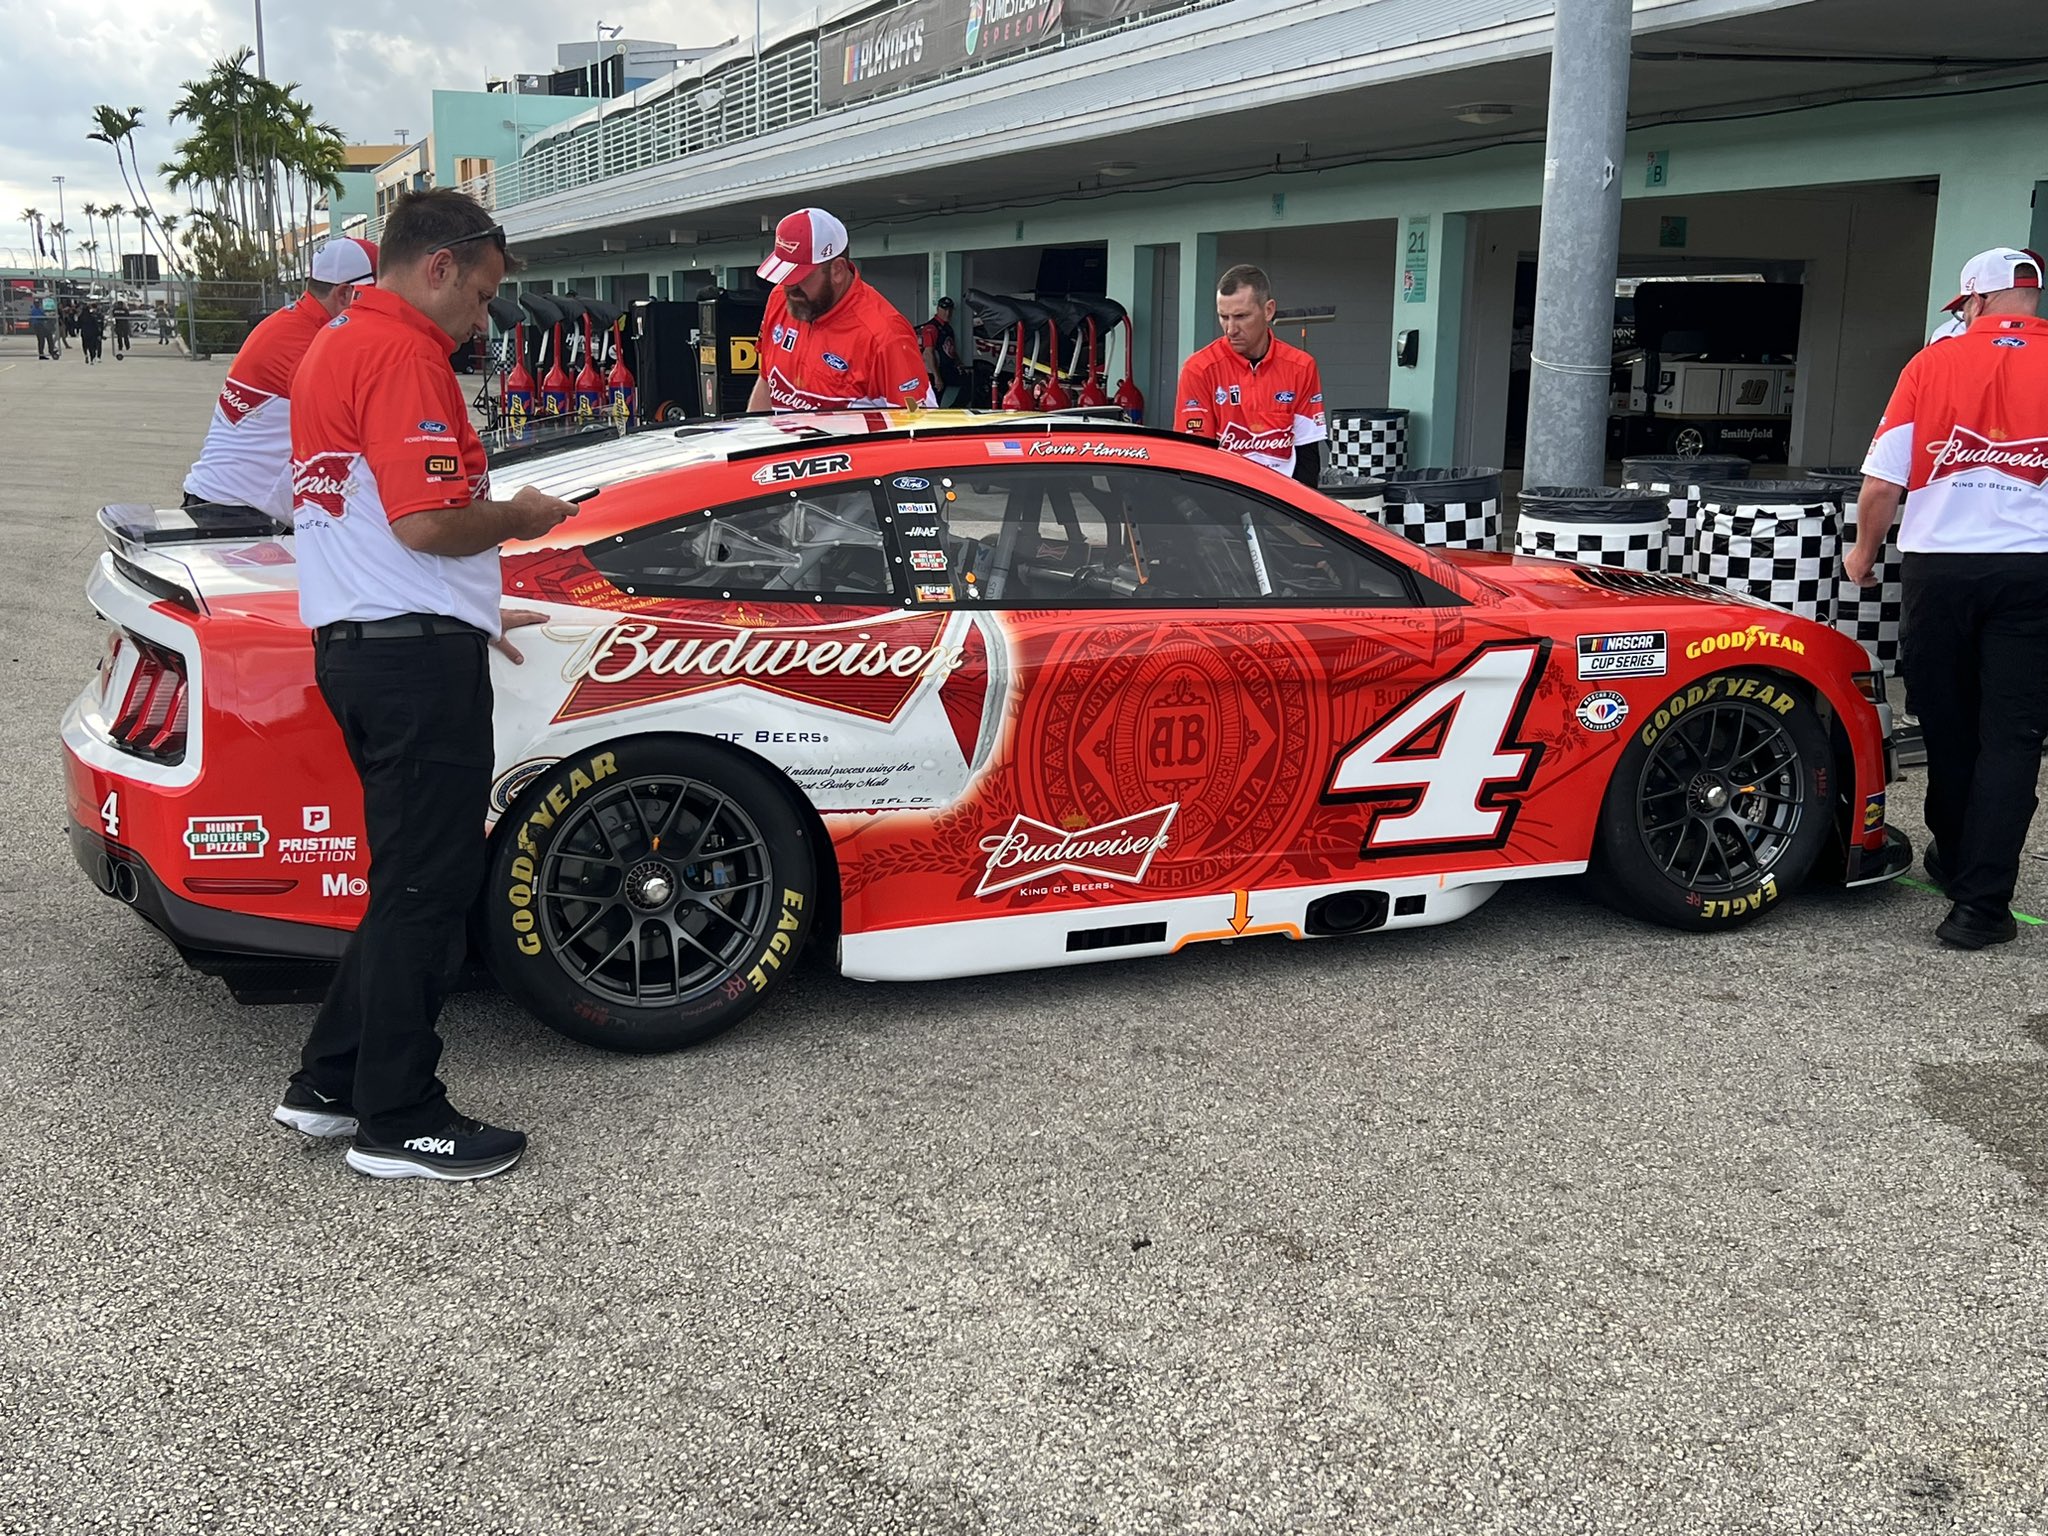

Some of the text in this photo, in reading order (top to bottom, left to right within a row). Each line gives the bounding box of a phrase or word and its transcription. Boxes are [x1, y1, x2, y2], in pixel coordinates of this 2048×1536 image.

[860, 18, 925, 80] PLAYOFFS
[1653, 166, 1662, 182] B
[821, 244, 833, 257] 4
[1408, 231, 1426, 253] 21
[1966, 276, 1977, 291] 4
[133, 322, 148, 333] 29
[825, 354, 846, 370] Ford
[1735, 379, 1769, 406] 10
[422, 423, 442, 432] Ford
[1720, 428, 1773, 441] Smithfield
[1028, 441, 1149, 459] Kevin Harvick
[429, 459, 455, 472] GW
[753, 454, 850, 484] 4EVER
[900, 479, 923, 489] Ford
[899, 504, 924, 512] Mobil
[905, 527, 940, 537] HAAS
[570, 583, 593, 598] This
[594, 580, 603, 590] is
[577, 599, 590, 607] by
[592, 592, 610, 603] any
[1606, 635, 1654, 651] NASCAR
[1685, 624, 1805, 660] GOODYEAR
[541, 623, 964, 684] Budweiser
[1591, 654, 1655, 670] CUP SERIES
[1229, 650, 1272, 710] EUROPE
[1081, 650, 1138, 728] AUSTRALIA
[1641, 676, 1796, 747] GOODYEAR
[1150, 713, 1207, 768] AB
[1327, 643, 1545, 852] 4
[790, 765, 833, 776] natural
[833, 766, 865, 778] process
[866, 763, 896, 776] using
[895, 762, 916, 773] the
[816, 779, 856, 791] Barley
[856, 776, 890, 787] Malt
[1081, 781, 1115, 825] AFRI
[1228, 777, 1267, 829] ASIA
[100, 791, 119, 836] 4
[309, 810, 324, 827] P
[205, 822, 245, 833] HUNT
[190, 832, 261, 843] BROTHERS
[278, 836, 357, 851] PRISTINE
[206, 842, 247, 853] PIZZA
[508, 751, 619, 957] GOODYEAR
[979, 829, 1169, 870] Budweiser
[280, 850, 357, 864] AUCTION
[1145, 862, 1215, 887] MERICA
[1020, 887, 1049, 897] KING
[1053, 885, 1067, 894] OF
[1686, 891, 1701, 907] RF
[1700, 879, 1779, 918] EAGLE
[746, 887, 804, 993] EAGLE
[720, 974, 747, 1000] RR
[403, 1137, 456, 1156] HOKA
